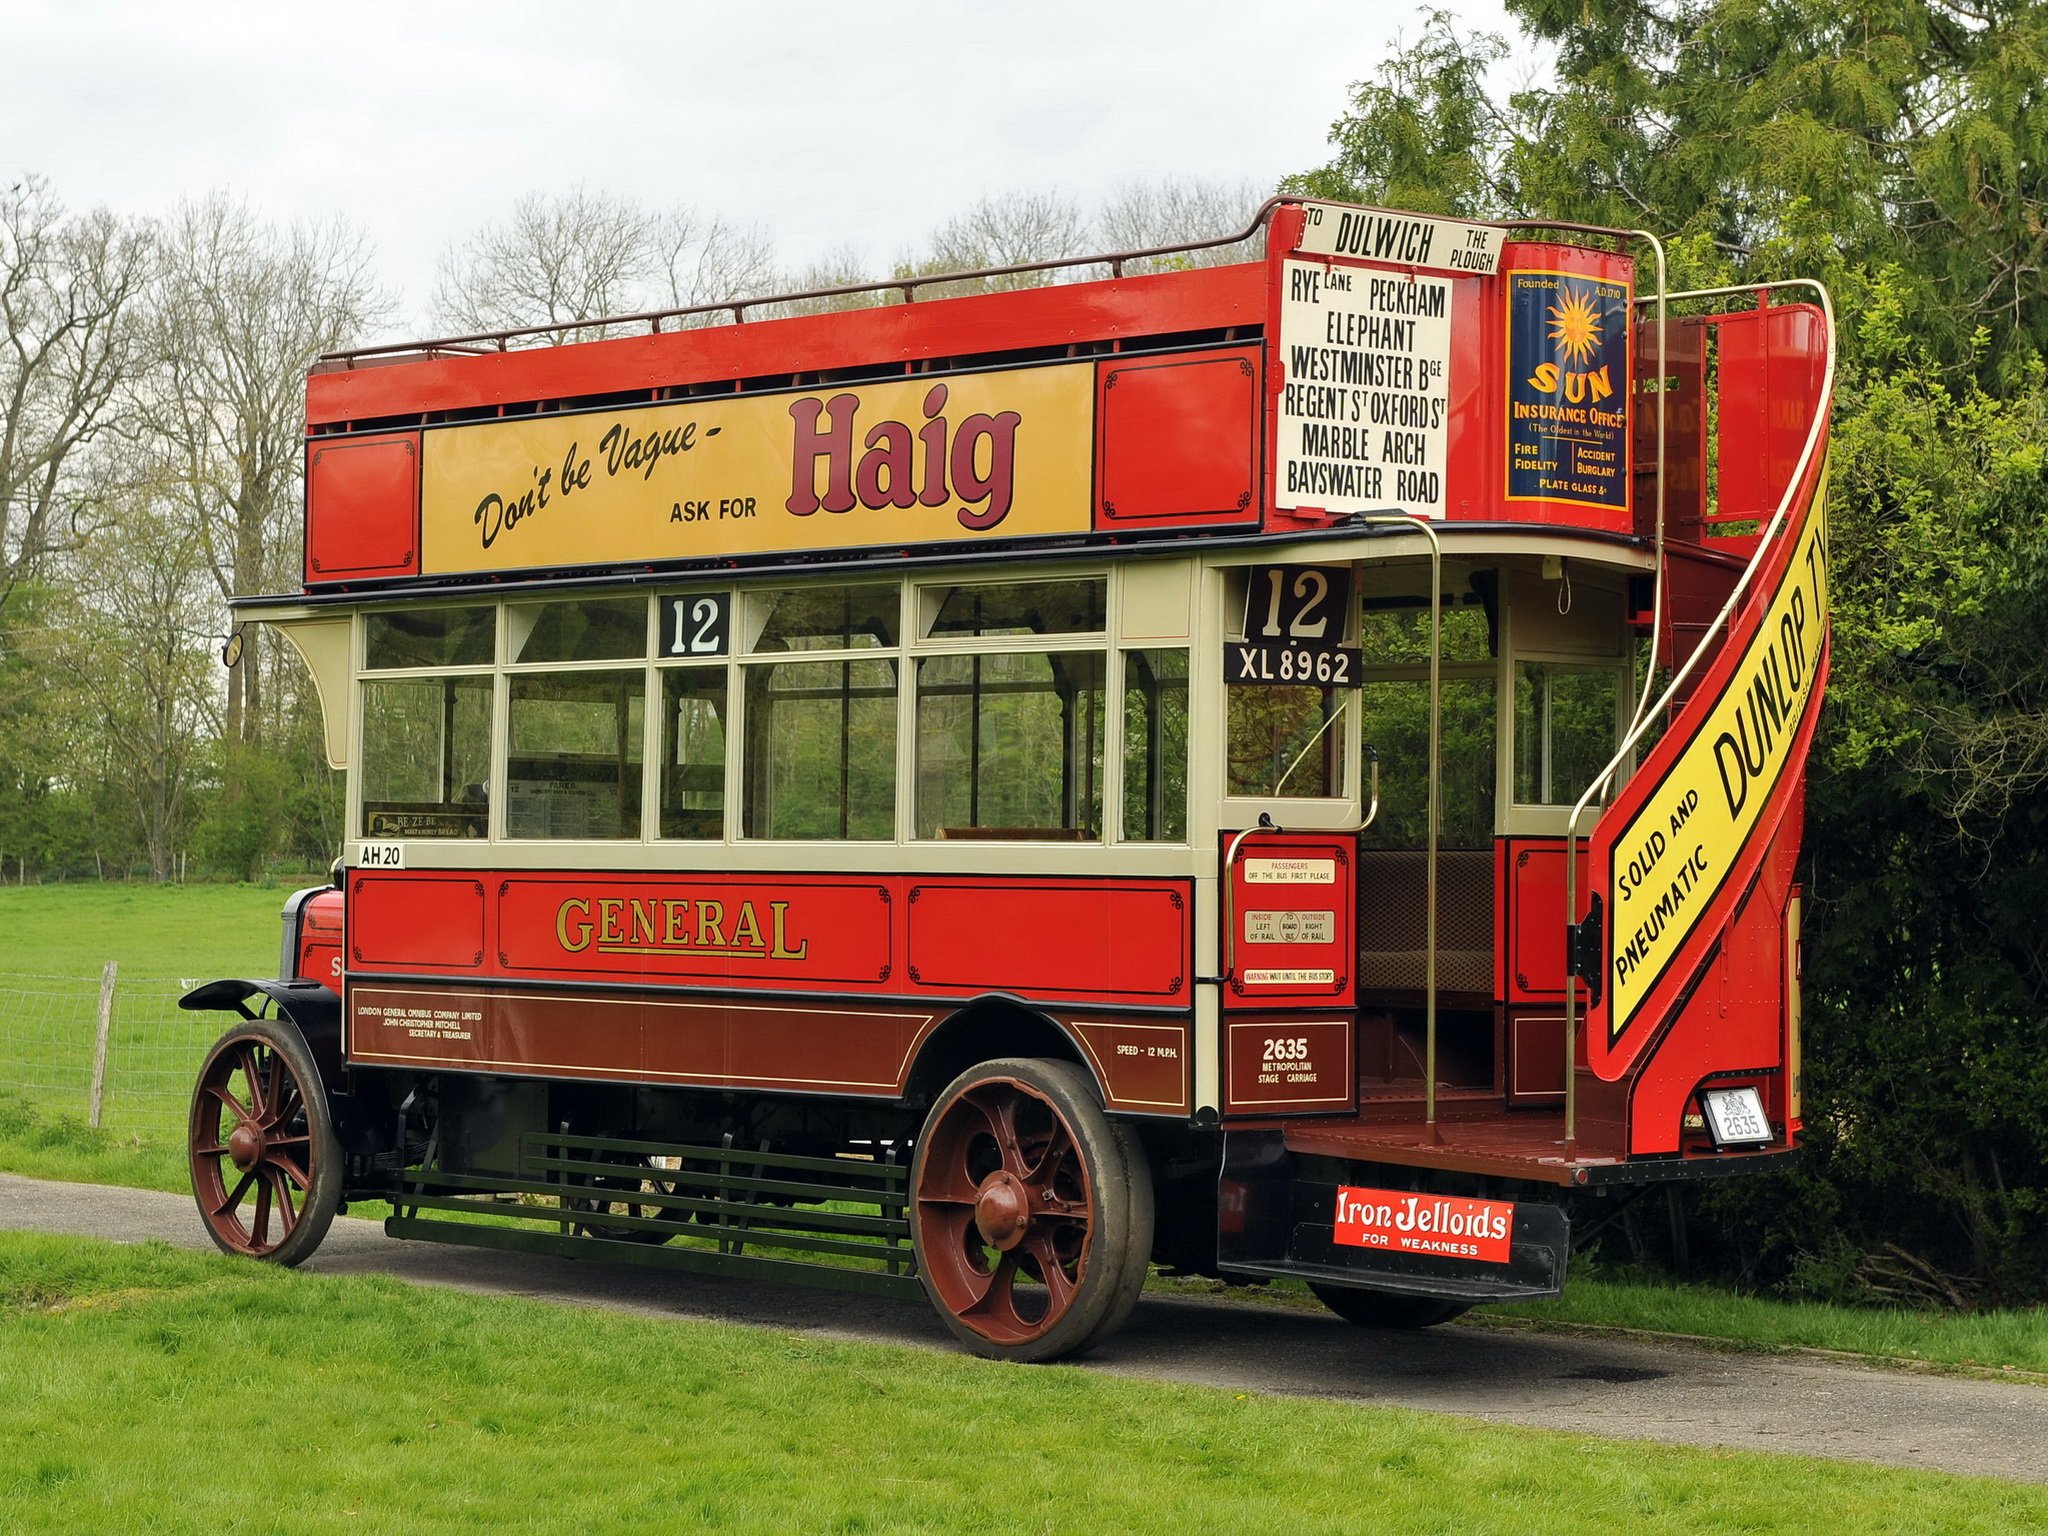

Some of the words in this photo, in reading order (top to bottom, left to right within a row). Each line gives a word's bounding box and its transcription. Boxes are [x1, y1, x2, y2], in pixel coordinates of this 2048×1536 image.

[1307, 207, 1323, 226] TO
[1335, 212, 1434, 263] DULWICH
[1466, 229, 1489, 249] THE
[1450, 249, 1495, 272] PLOUGH
[1291, 268, 1321, 304] RYE
[1324, 271, 1352, 292] LANE
[1369, 278, 1446, 318] PECKHAM
[1517, 278, 1560, 289] Founded
[1326, 311, 1416, 352] ELEPHANT
[1291, 345, 1413, 390] WESTMINSTER
[1527, 362, 1614, 404] SUN
[1285, 383, 1348, 421] REGENT
[1370, 391, 1428, 429] OXFORD
[1513, 401, 1587, 424] INSURANCE
[1550, 424, 1573, 436] Oldest
[1582, 429, 1592, 437] the
[1302, 423, 1369, 461] MARBLE
[1382, 431, 1426, 466] ARCH
[1514, 443, 1538, 455] FIRE
[1577, 447, 1616, 462] ACCIDENT
[785, 382, 1022, 532] Haig
[1515, 459, 1558, 471] FIDELITY
[1577, 462, 1616, 478] BURGLARY
[1287, 460, 1382, 499] BAYSWATER
[1397, 469, 1439, 504] ROAD
[1539, 478, 1569, 490] PLATE
[1571, 482, 1597, 494] GLASS
[474, 465, 552, 550] Don't
[560, 441, 592, 497] be
[670, 500, 710, 523] ASK
[719, 497, 757, 520] FOR
[1262, 569, 1328, 638] 12
[671, 598, 720, 653] 12
[1713, 585, 1807, 823] DUNLOP
[361, 846, 381, 865] AH
[383, 846, 400, 865] 20
[1618, 830, 1666, 902] SOLID
[1669, 789, 1699, 838] AND
[1271, 862, 1308, 870] PASSENGERS
[1291, 872, 1307, 880] FIRST
[1310, 872, 1330, 880] PLEASE
[1251, 913, 1273, 921] INSIDE
[1301, 913, 1326, 921] OUTSIDE
[1615, 844, 1709, 987] PNEUMATIC
[555, 897, 808, 960] GENERAL
[1246, 972, 1269, 981] WARNING
[1282, 972, 1297, 981] UNTIL
[1298, 972, 1307, 981] THE
[1308, 972, 1318, 981] BUS
[1319, 972, 1332, 981] STOPS
[357, 1006, 382, 1016] LONDON
[383, 1008, 407, 1017] GENERAL
[408, 1009, 432, 1018] OMNIBUS
[433, 1010, 460, 1020] COMPANY
[461, 1012, 482, 1021] LIMITED
[383, 1018, 398, 1027] JOHN
[399, 1019, 434, 1028] CHRISTOPHER
[435, 1020, 460, 1030] MITCHELL
[408, 1029, 437, 1038] SECRETARY
[442, 1031, 471, 1040] TREASURER
[1116, 1044, 1139, 1056] SPEED
[1147, 1046, 1155, 1057] 12
[1263, 1038, 1308, 1060] 2635
[1262, 1062, 1312, 1071] METROPOLITAN
[1258, 1074, 1280, 1083] STAGE
[1286, 1073, 1318, 1082] CARRIAGE
[1723, 1115, 1760, 1136] 2635
[1337, 1191, 1392, 1228] Iron
[1362, 1233, 1389, 1246] FOR
[1400, 1237, 1478, 1256] WEAKNESS
